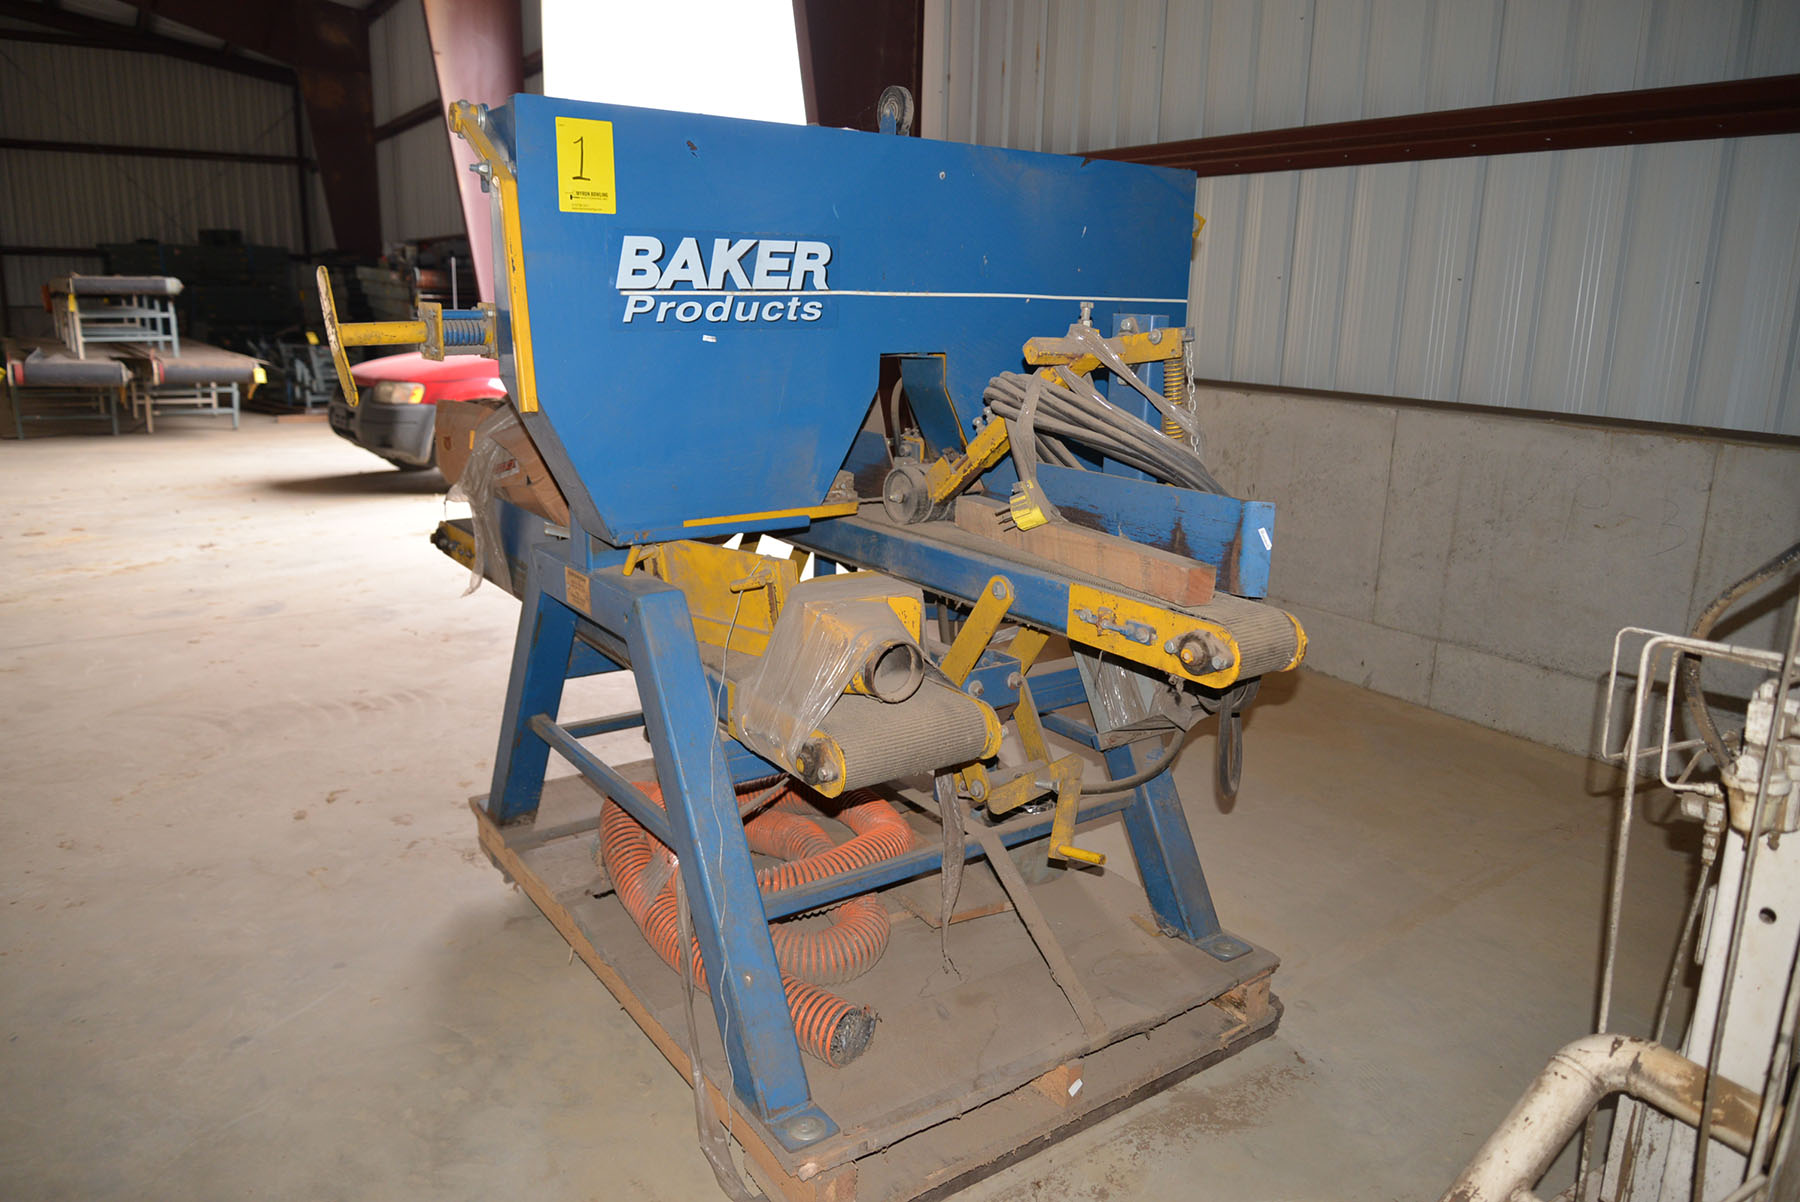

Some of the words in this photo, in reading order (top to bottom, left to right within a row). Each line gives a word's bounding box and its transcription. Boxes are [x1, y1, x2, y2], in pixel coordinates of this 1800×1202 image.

[572, 136, 591, 181] 1
[615, 235, 832, 290] BAKER
[622, 295, 824, 322] Products
